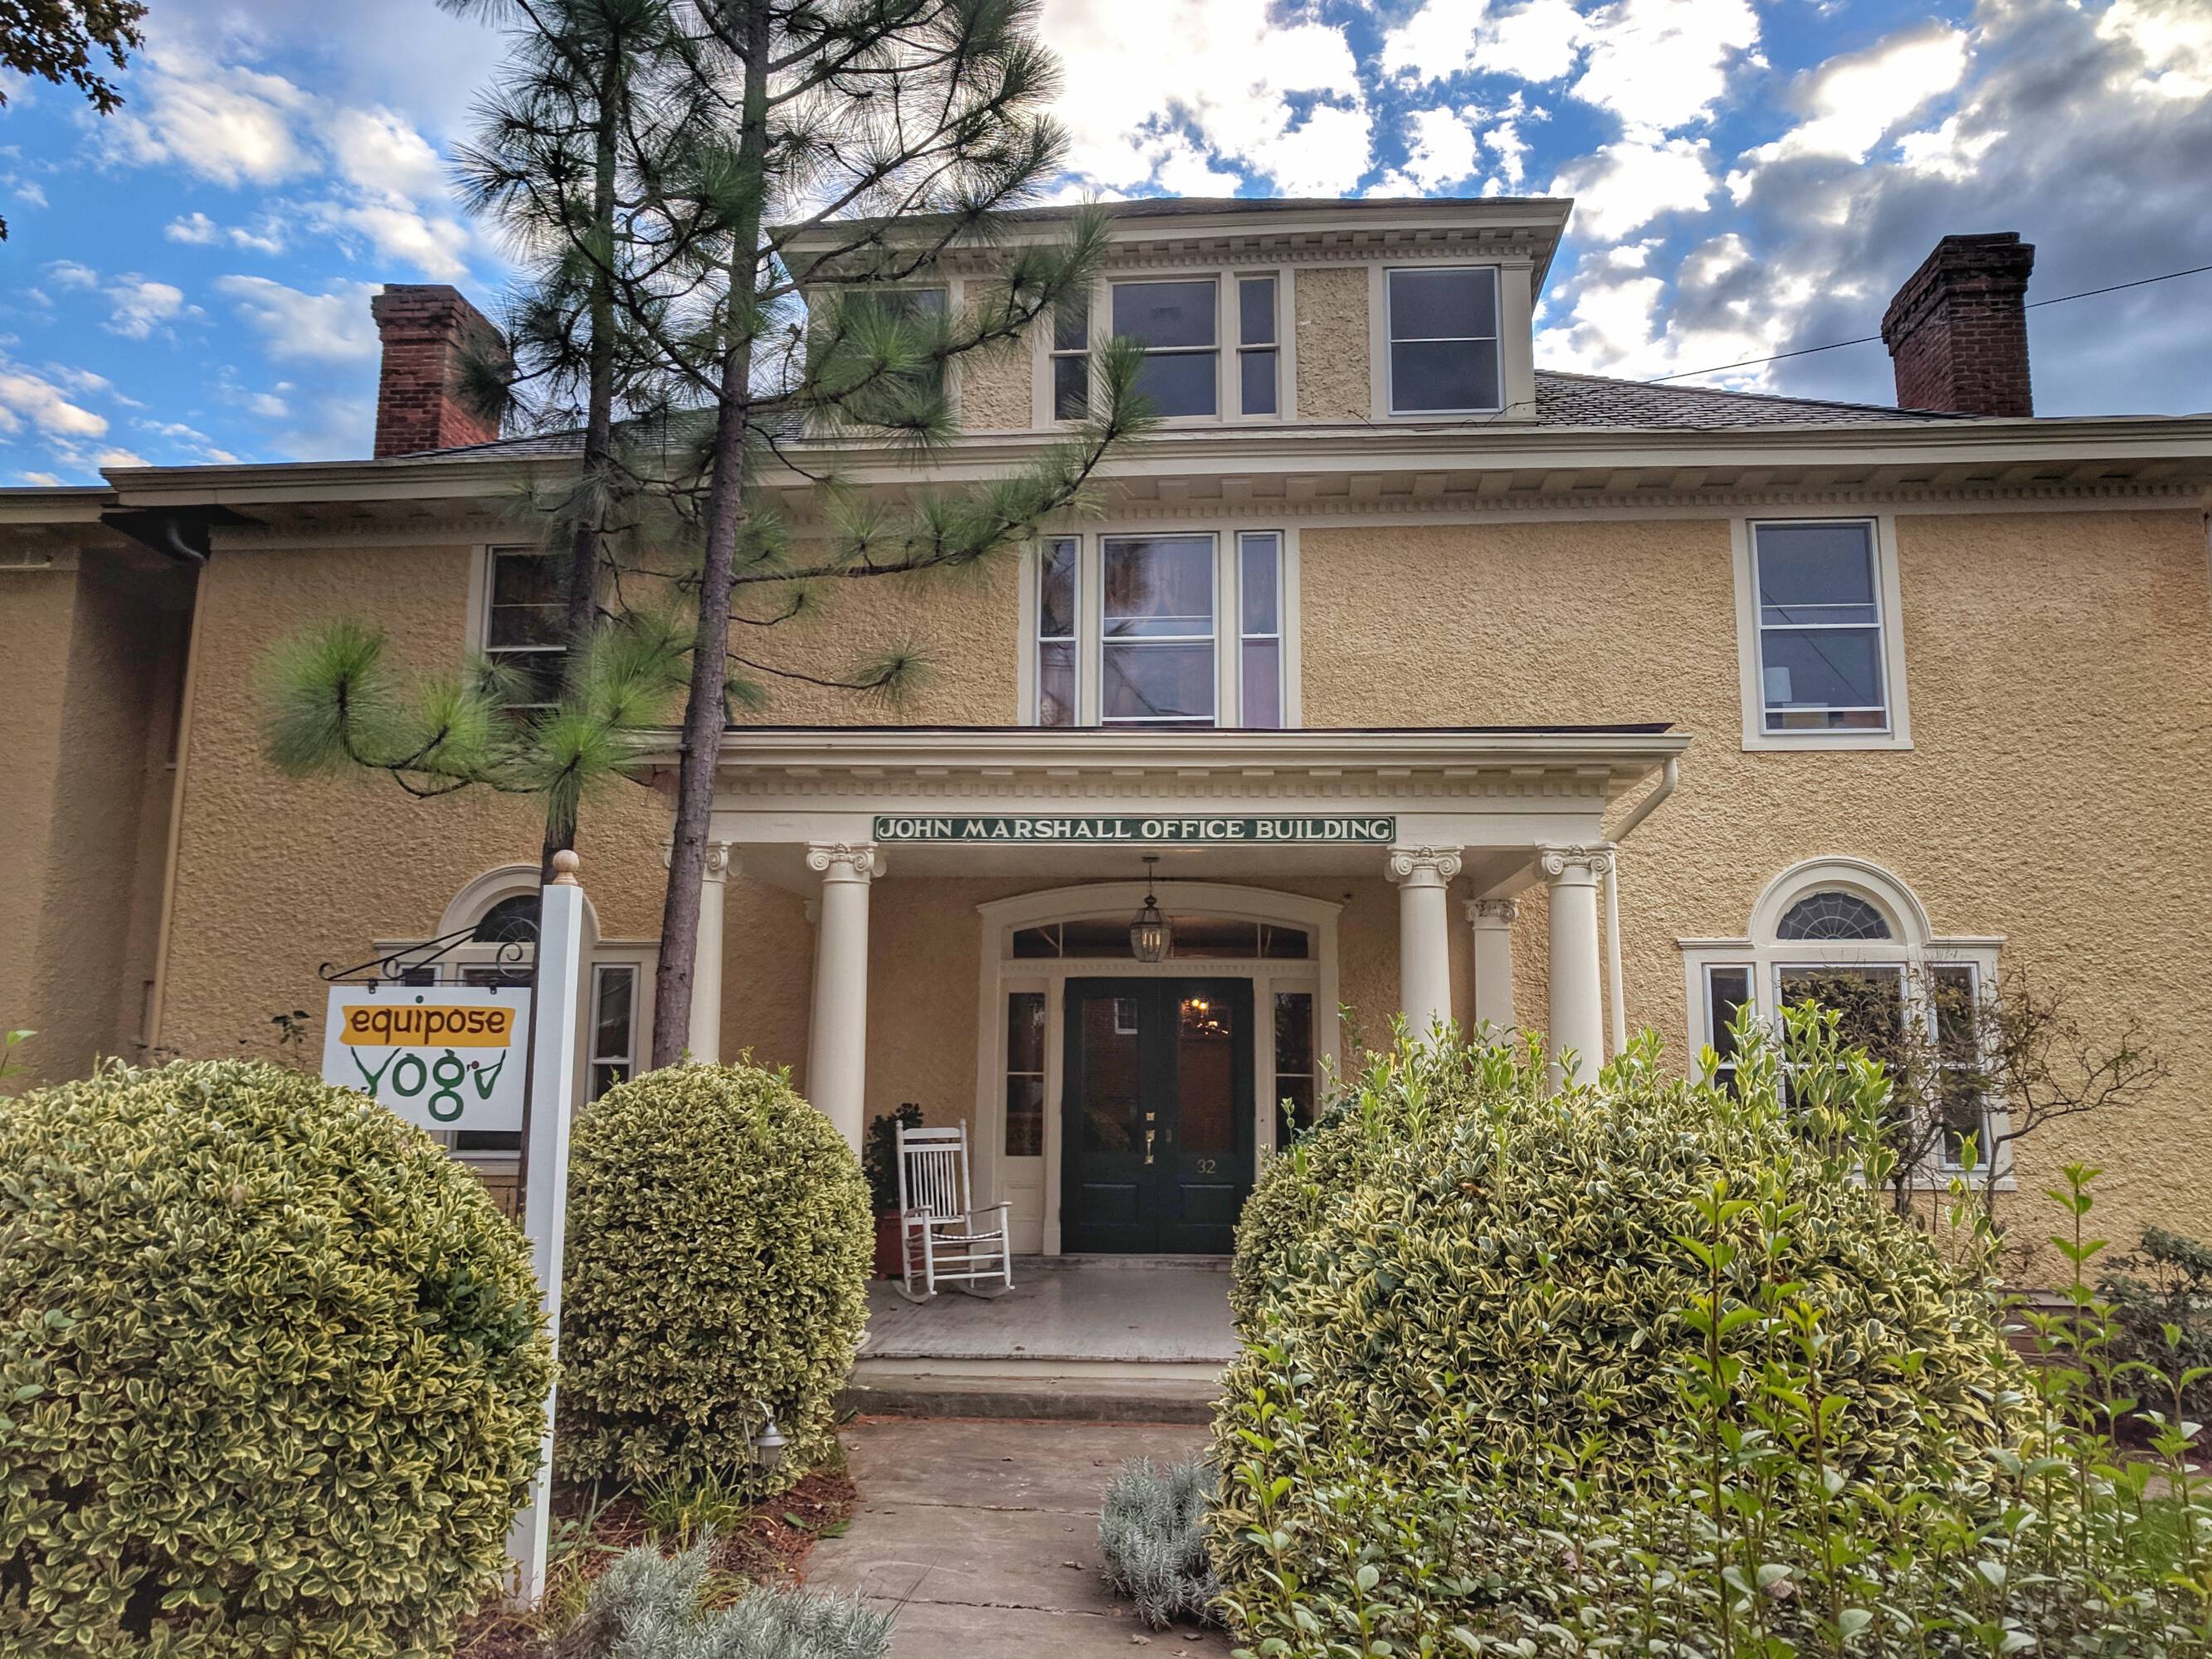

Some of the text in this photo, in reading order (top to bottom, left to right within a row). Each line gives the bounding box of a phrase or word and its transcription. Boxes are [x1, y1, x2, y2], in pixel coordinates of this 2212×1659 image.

[879, 820, 1391, 839] JOHN MARSHALL OFFICE BUILDING
[351, 995, 505, 1045] equipose
[1196, 1159, 1216, 1174] 32
